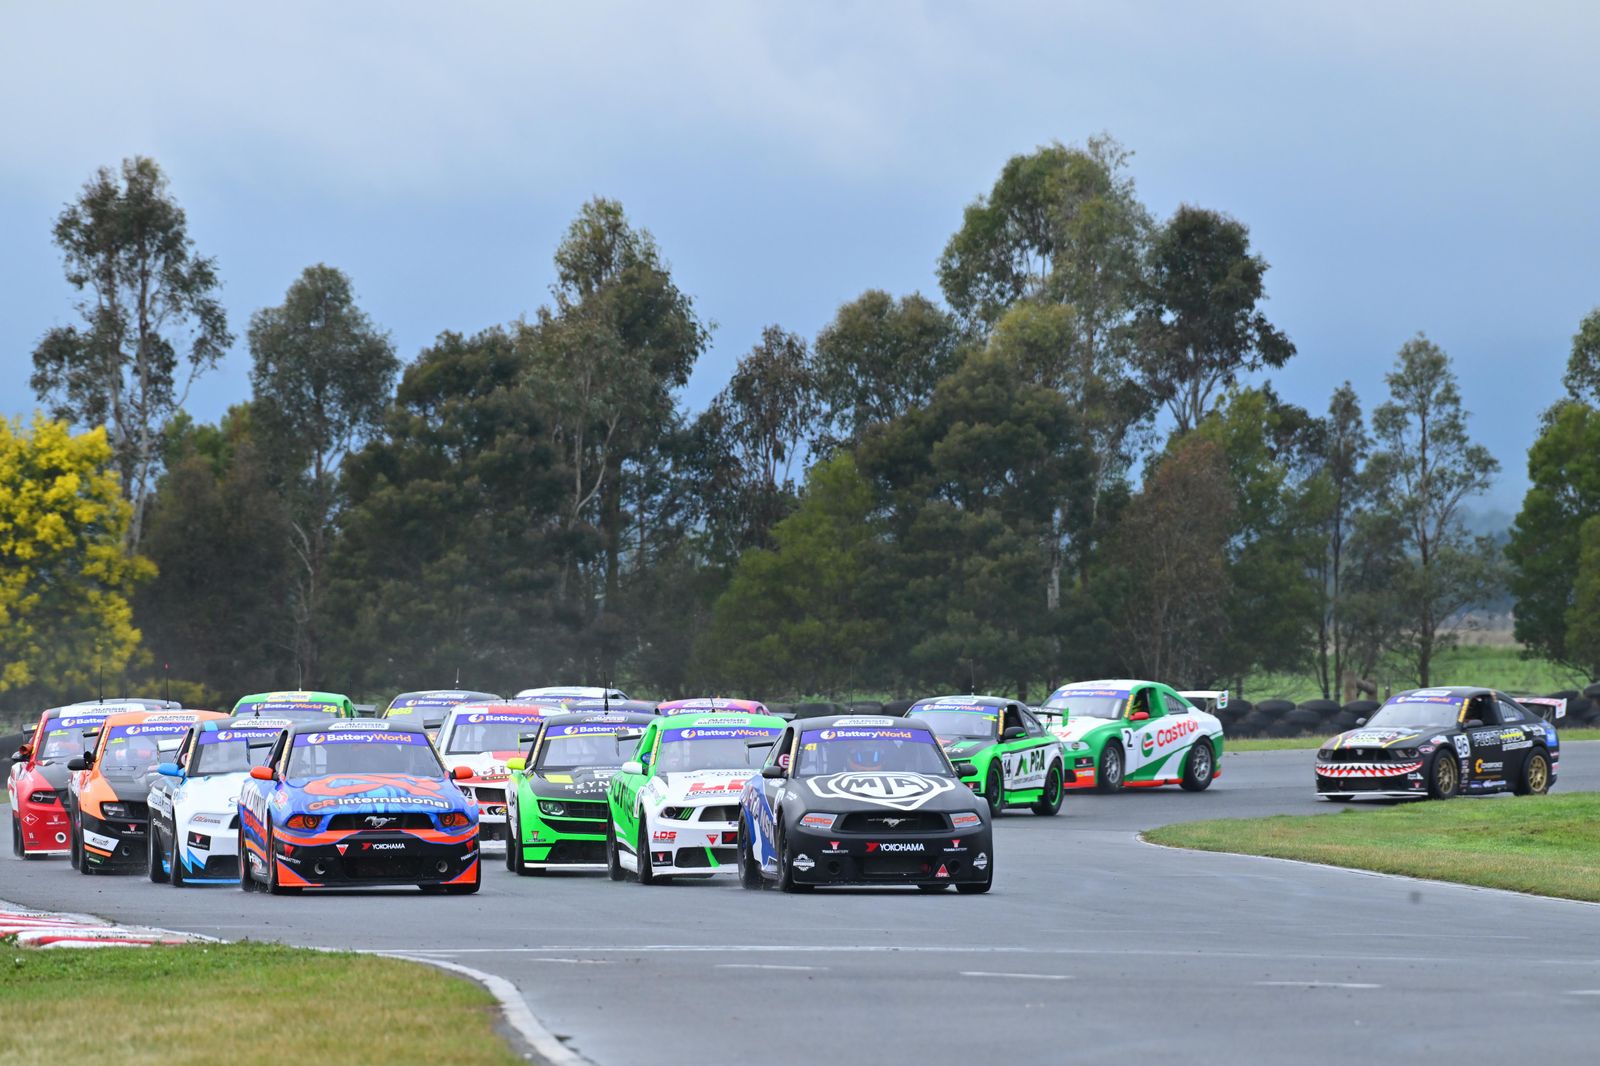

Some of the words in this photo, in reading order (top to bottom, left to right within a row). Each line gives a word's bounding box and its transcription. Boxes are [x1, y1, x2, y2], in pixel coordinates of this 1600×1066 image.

[322, 705, 338, 713] 28
[696, 729, 769, 737] BatteryWorld
[837, 730, 912, 739] BatteryWorld
[1157, 718, 1199, 747] Castrol
[327, 733, 412, 743] BatteryWorld
[1124, 730, 1134, 748] 2
[1030, 749, 1045, 772] PGA
[308, 799, 336, 810] CR
[338, 796, 449, 809] International
[653, 831, 677, 839] LDS
[371, 842, 406, 850] YOKOHAMA
[879, 843, 925, 851] YOKOHAMA
